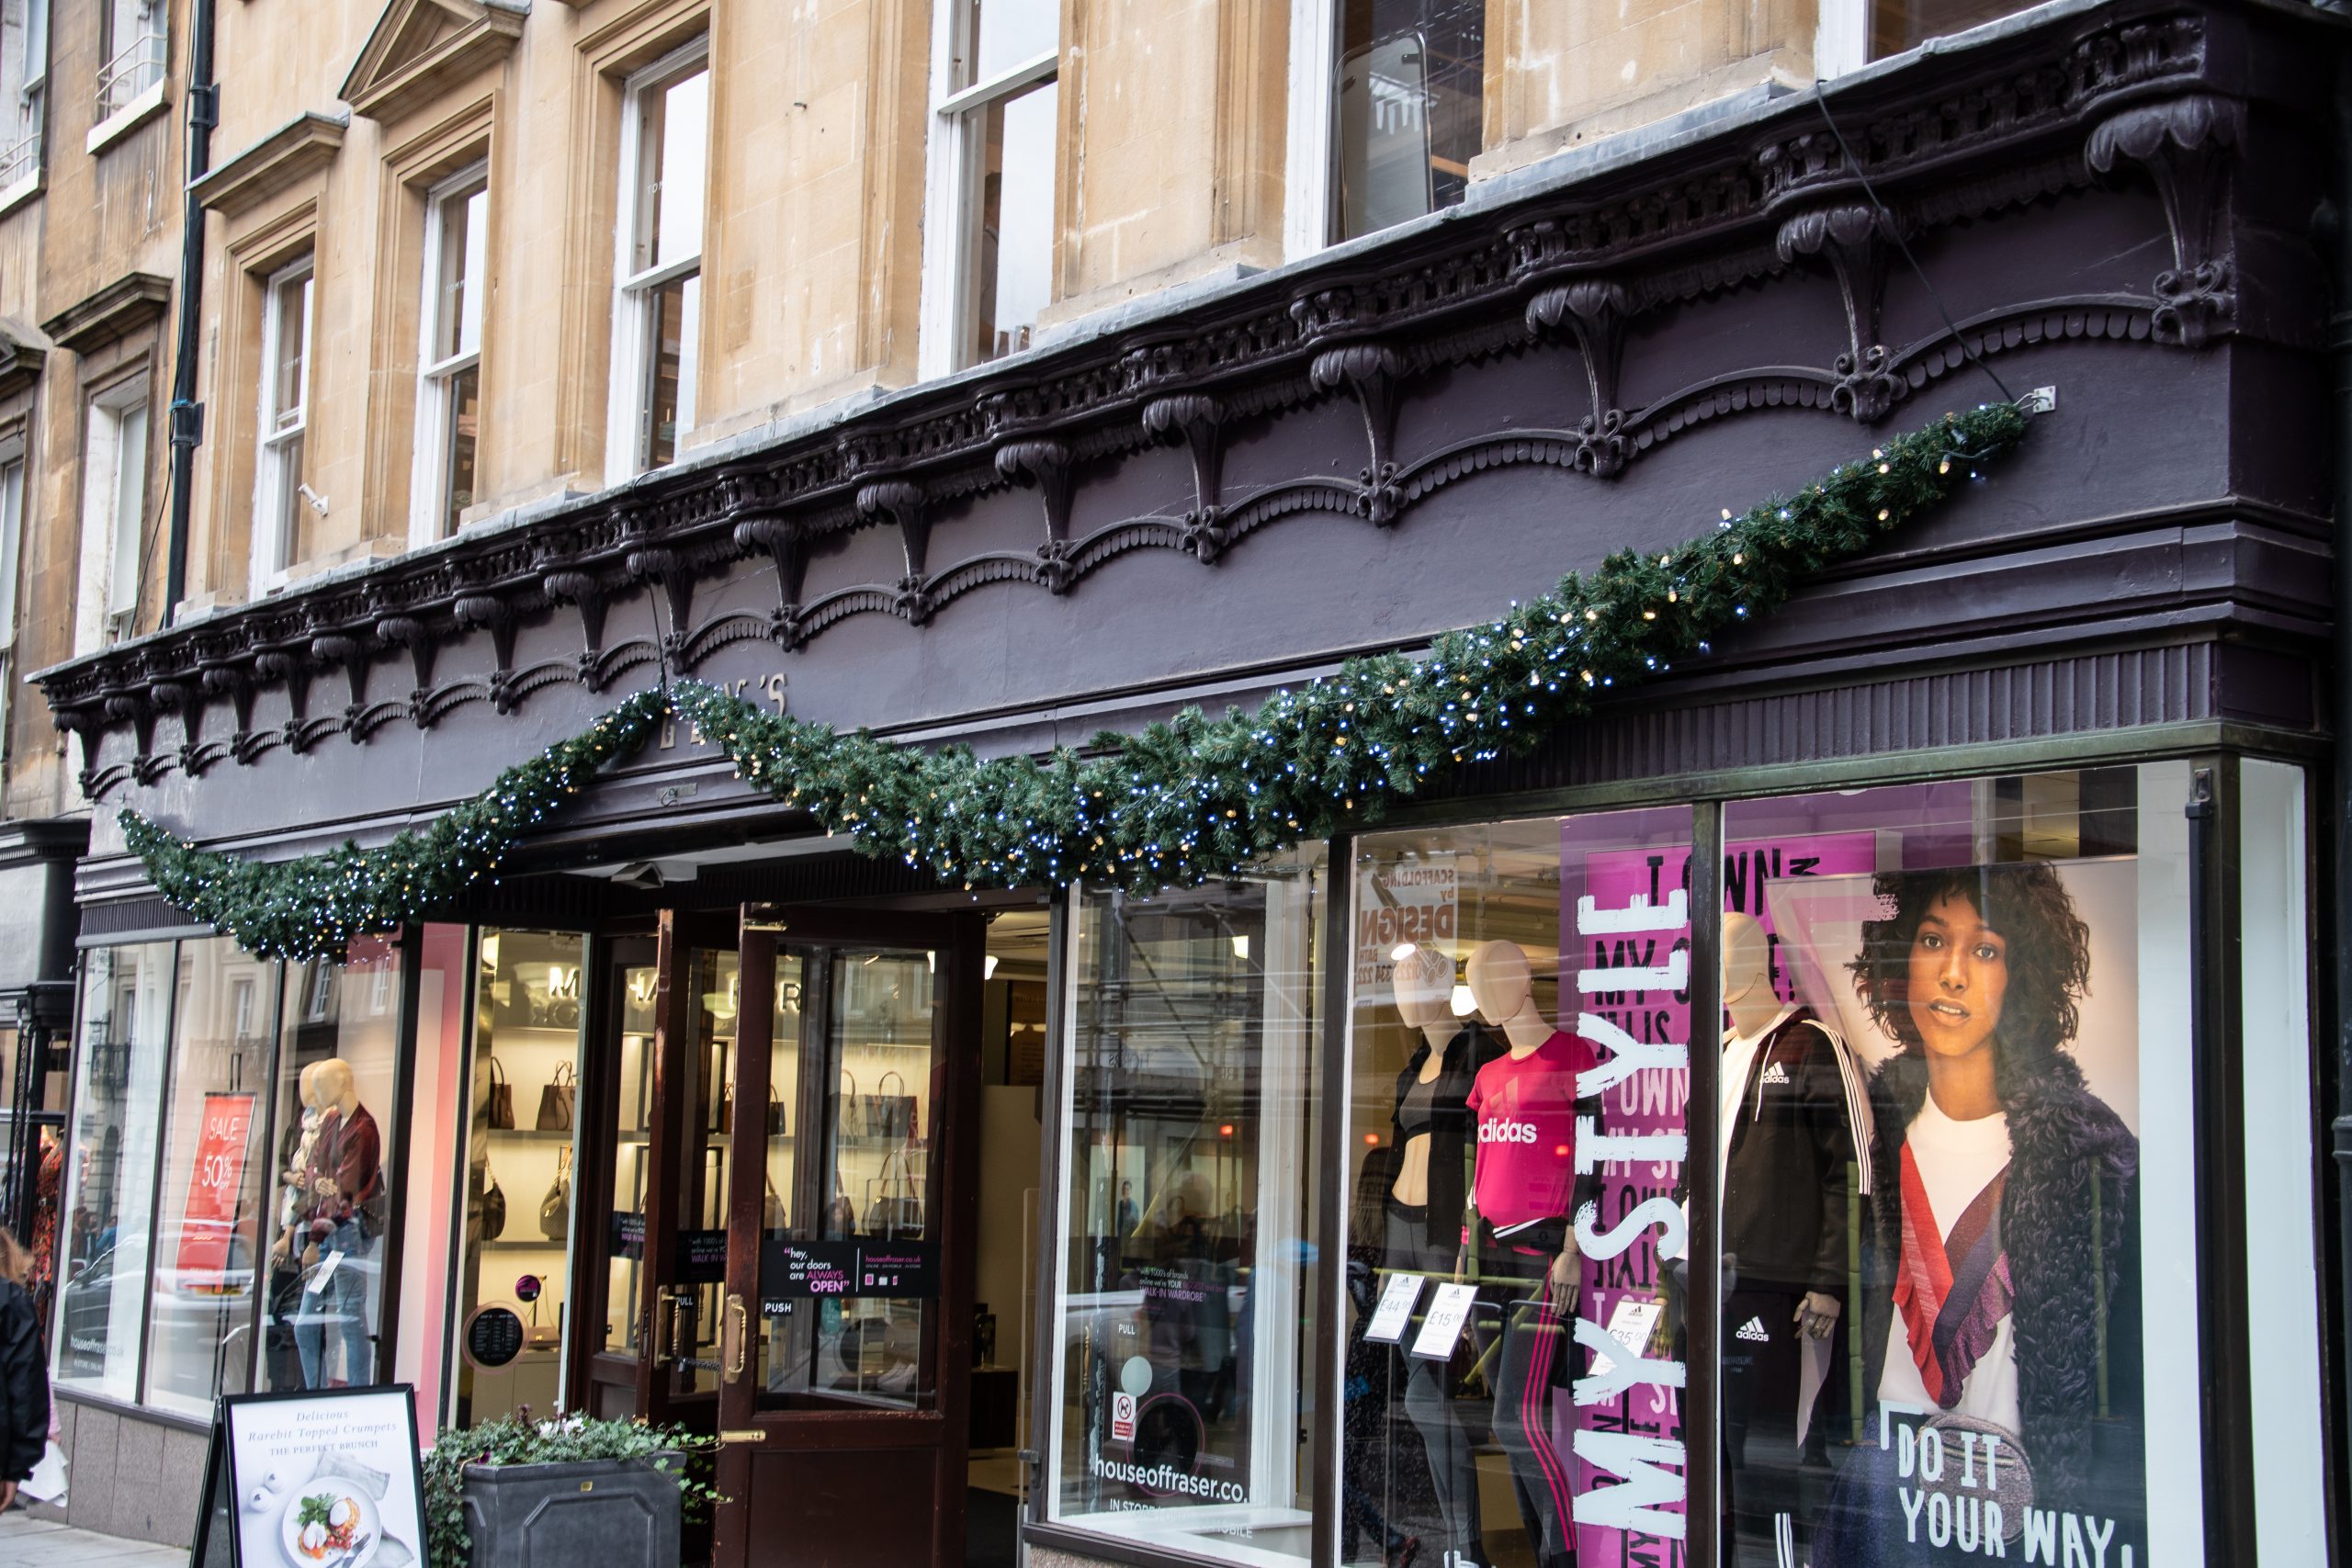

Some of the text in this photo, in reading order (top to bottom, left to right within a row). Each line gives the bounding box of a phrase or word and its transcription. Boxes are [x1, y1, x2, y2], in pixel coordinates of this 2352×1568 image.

[1574, 888, 1689, 1260] STYLE
[209, 1116, 241, 1141] SALE
[1477, 1116, 1538, 1145] didas
[201, 1155, 232, 1187] 50%
[789, 1259, 831, 1270] our doors
[789, 1269, 844, 1280] are ALWAYS
[1168, 1280, 1182, 1289] YOUR
[1139, 1286, 1167, 1299] WALK-IN
[764, 1302, 792, 1314] PUSH
[1118, 1324, 1136, 1335] PULL
[1736, 1329, 1770, 1342] adidas
[296, 1410, 350, 1423] Delicious
[248, 1421, 397, 1442] Rarebit Topped Crumpets
[270, 1439, 379, 1456] THE PERFECT BRUNCH
[1898, 1423, 2002, 1492] DO IT
[1110, 1498, 1120, 1511] IN
[1898, 1486, 2006, 1559] YOUR
